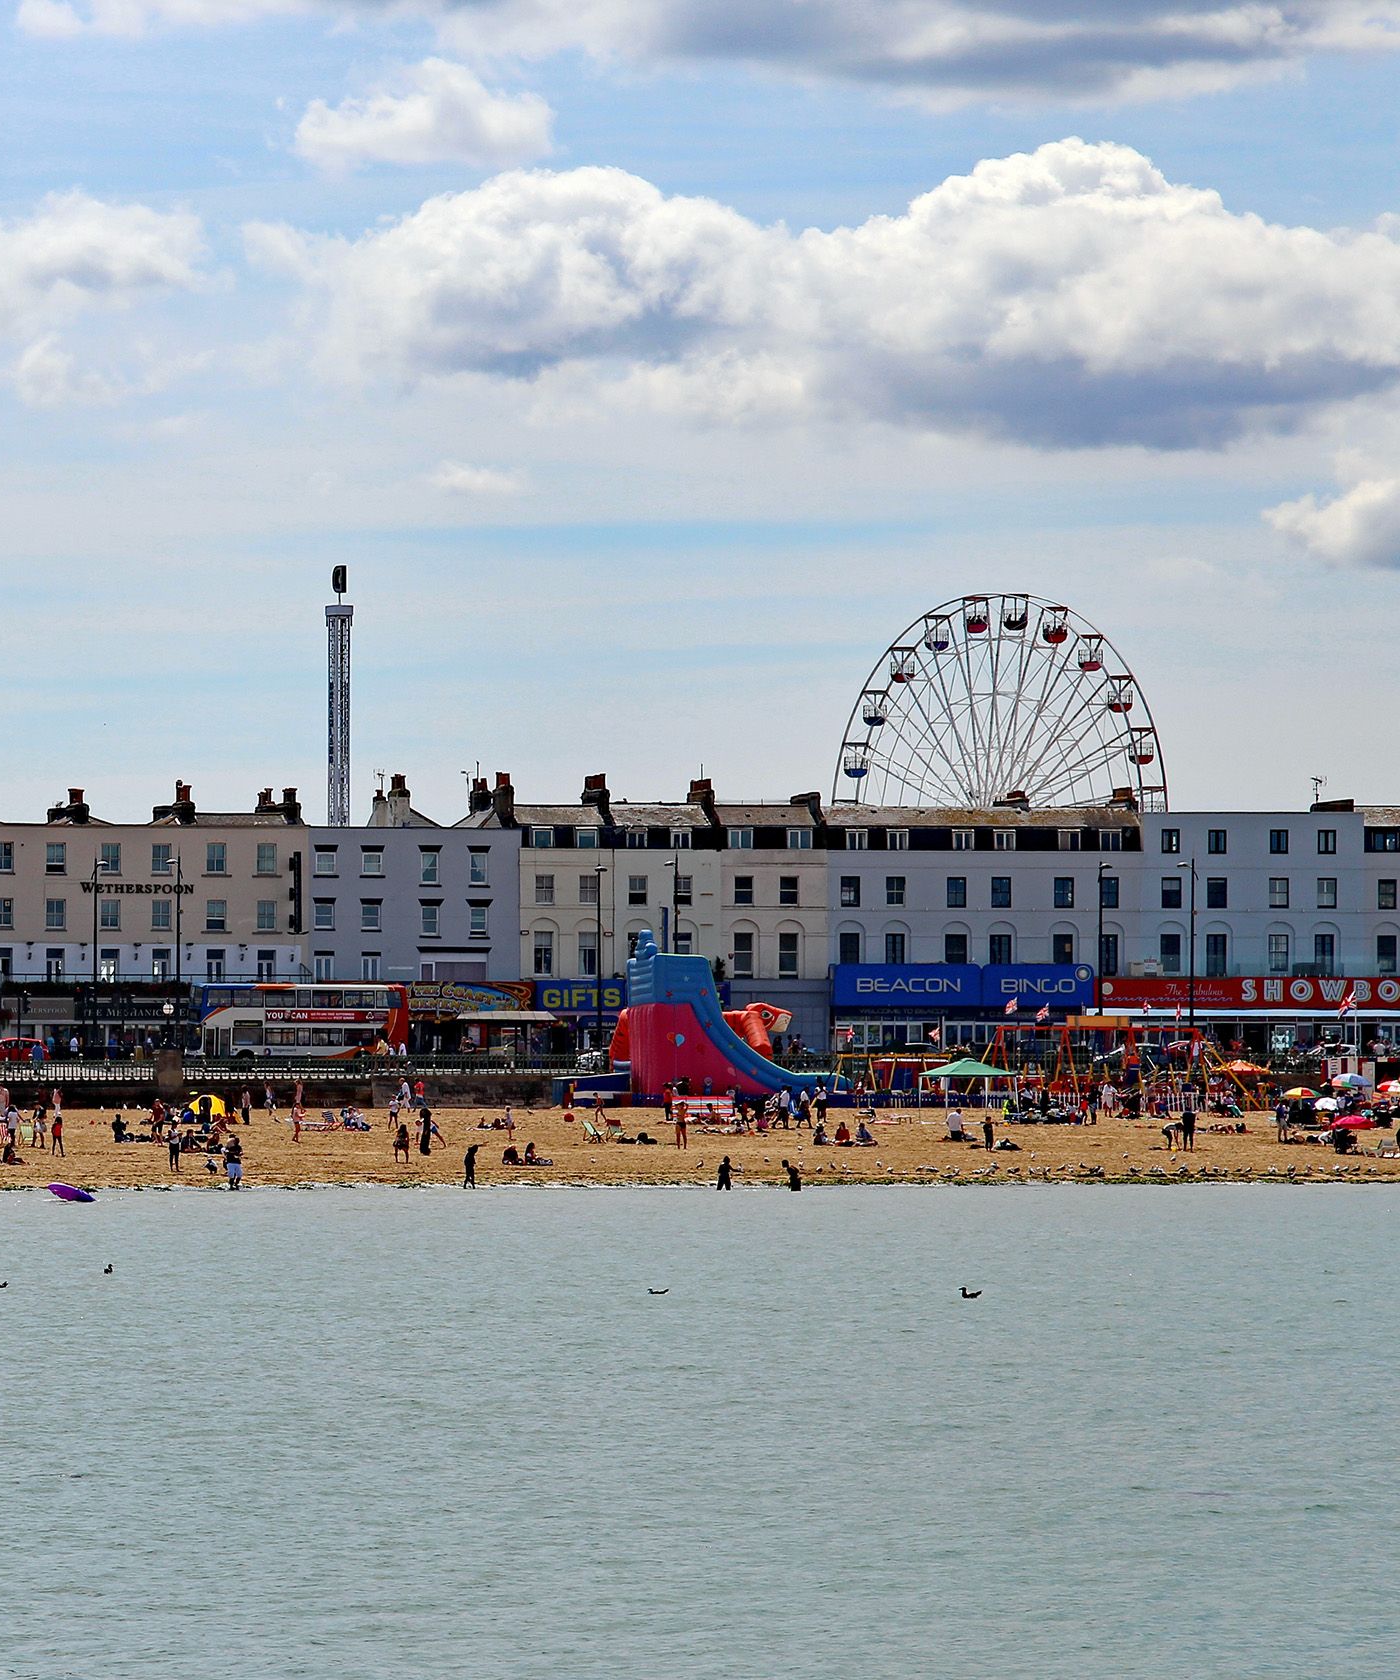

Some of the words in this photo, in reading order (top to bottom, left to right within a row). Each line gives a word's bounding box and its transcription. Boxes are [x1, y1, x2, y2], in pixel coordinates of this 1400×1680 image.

[80, 882, 195, 895] WETHERSPOON
[856, 978, 961, 993] BEACON
[1000, 978, 1076, 993] BINGO
[542, 987, 621, 1009] GIFTS
[266, 1012, 284, 1020] YOU
[290, 1012, 308, 1020] CAN
